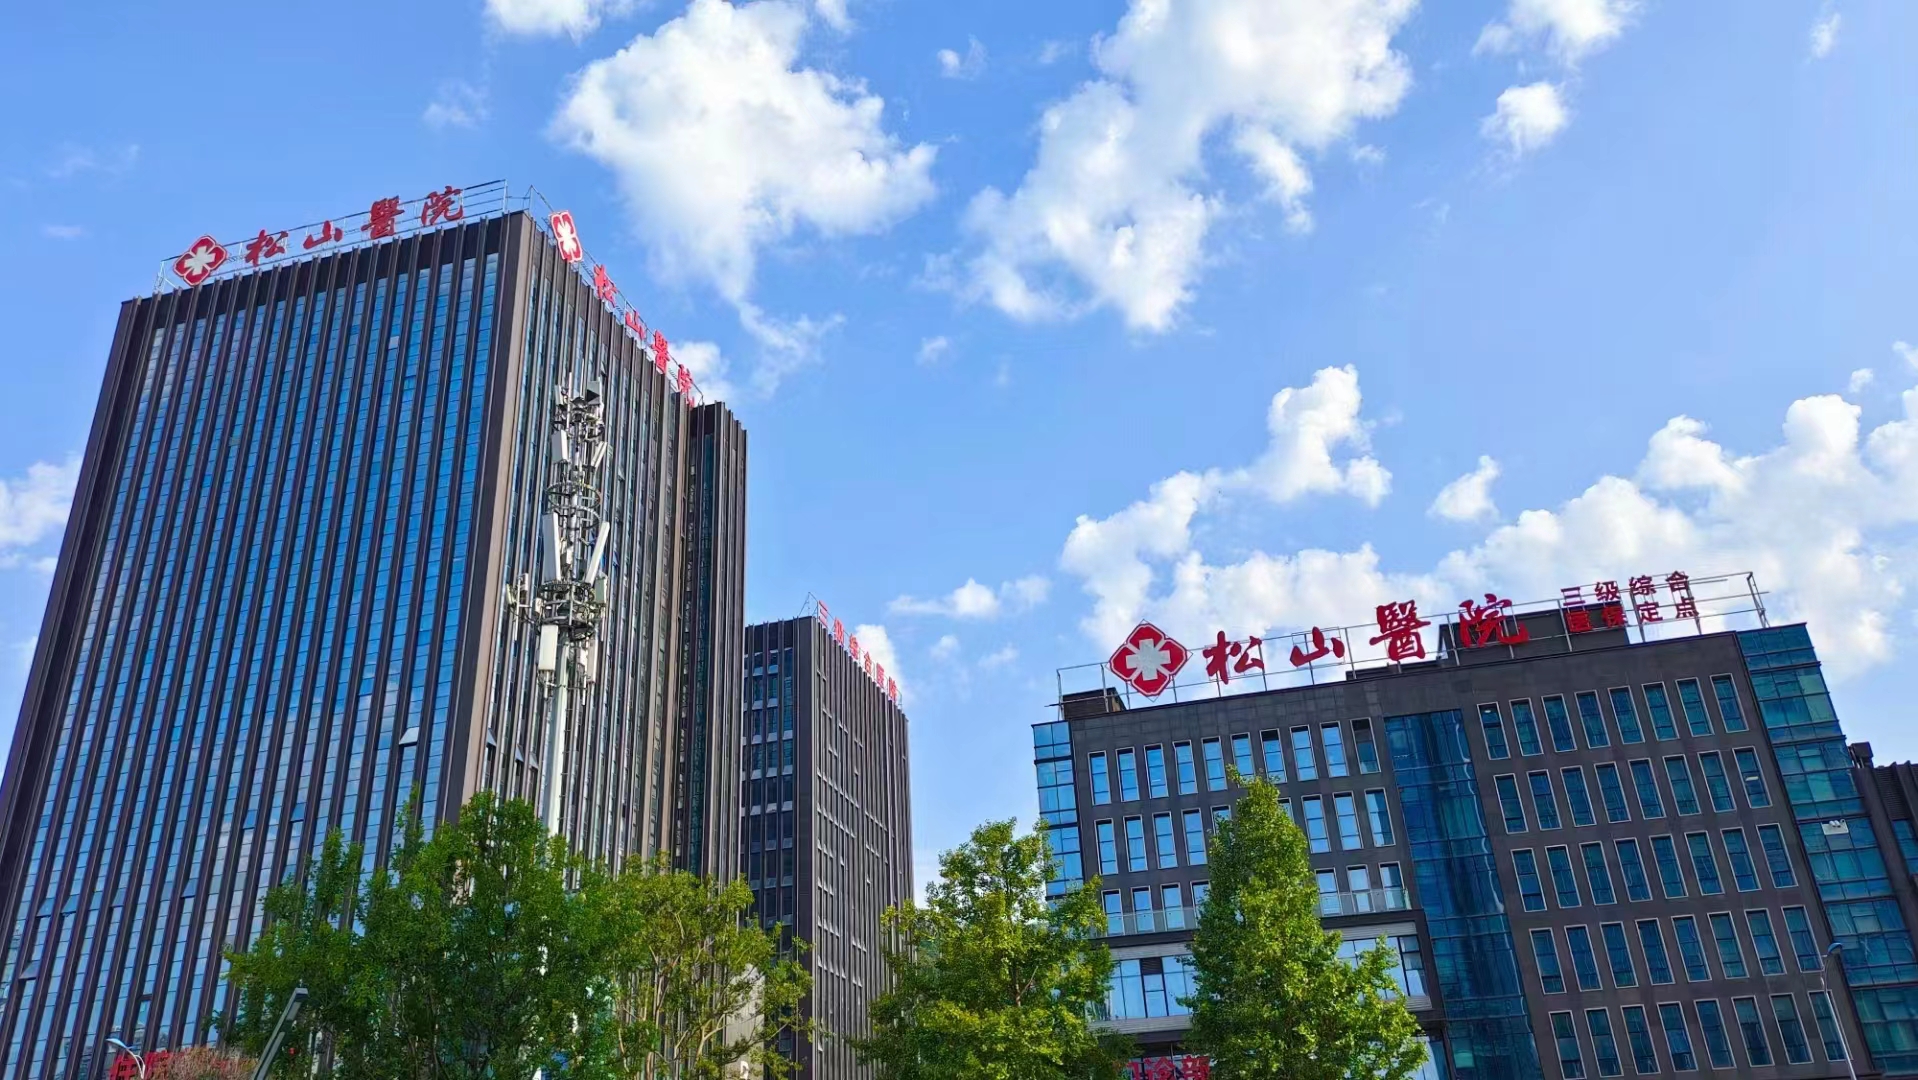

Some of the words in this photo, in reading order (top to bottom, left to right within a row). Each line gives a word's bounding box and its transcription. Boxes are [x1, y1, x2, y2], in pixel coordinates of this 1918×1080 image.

[245, 186, 463, 267] 松山醫院
[1561, 571, 1690, 607] 三级综合
[1565, 596, 1699, 633] 医保定点
[1202, 593, 1529, 685] 松山醫院
